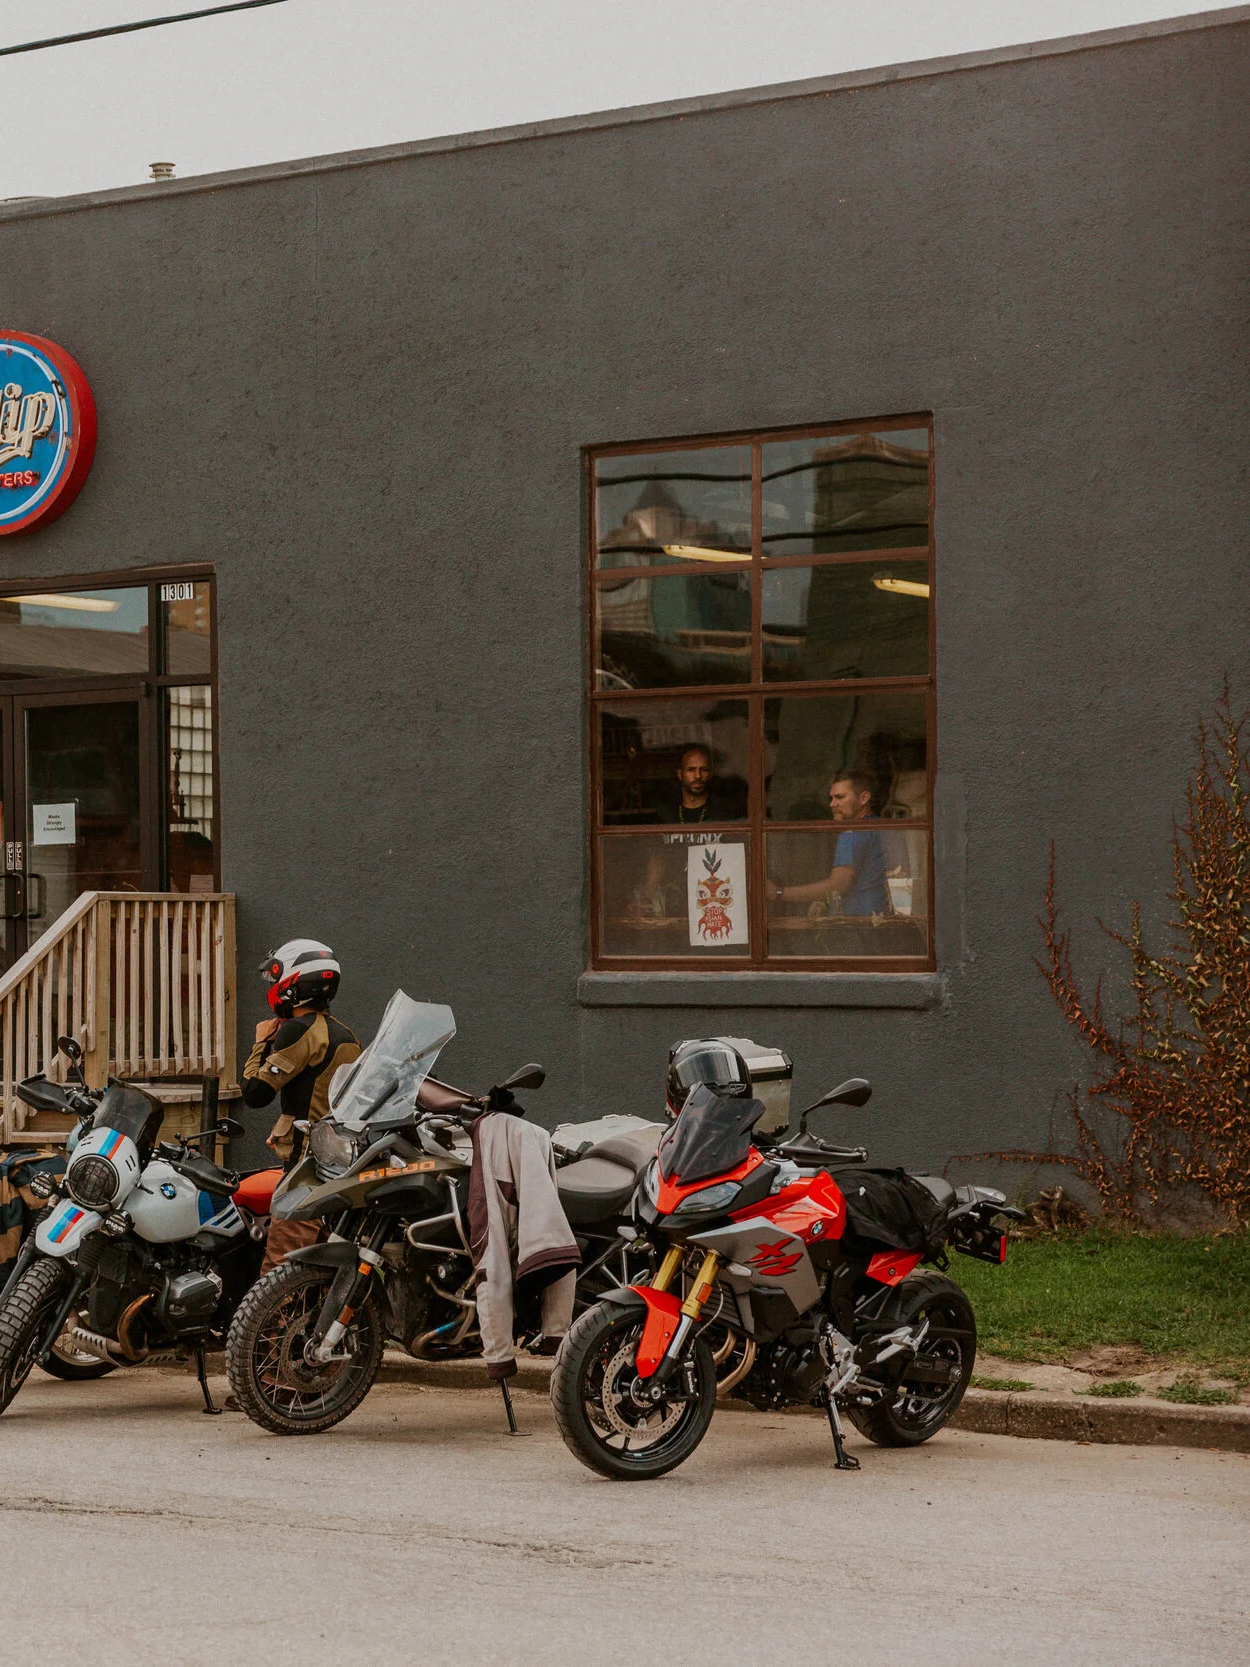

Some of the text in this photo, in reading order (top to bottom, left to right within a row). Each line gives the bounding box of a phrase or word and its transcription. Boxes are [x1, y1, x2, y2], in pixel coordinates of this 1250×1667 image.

[162, 583, 192, 600] 1301
[706, 907, 723, 916] STOP
[707, 920, 723, 929] HATE
